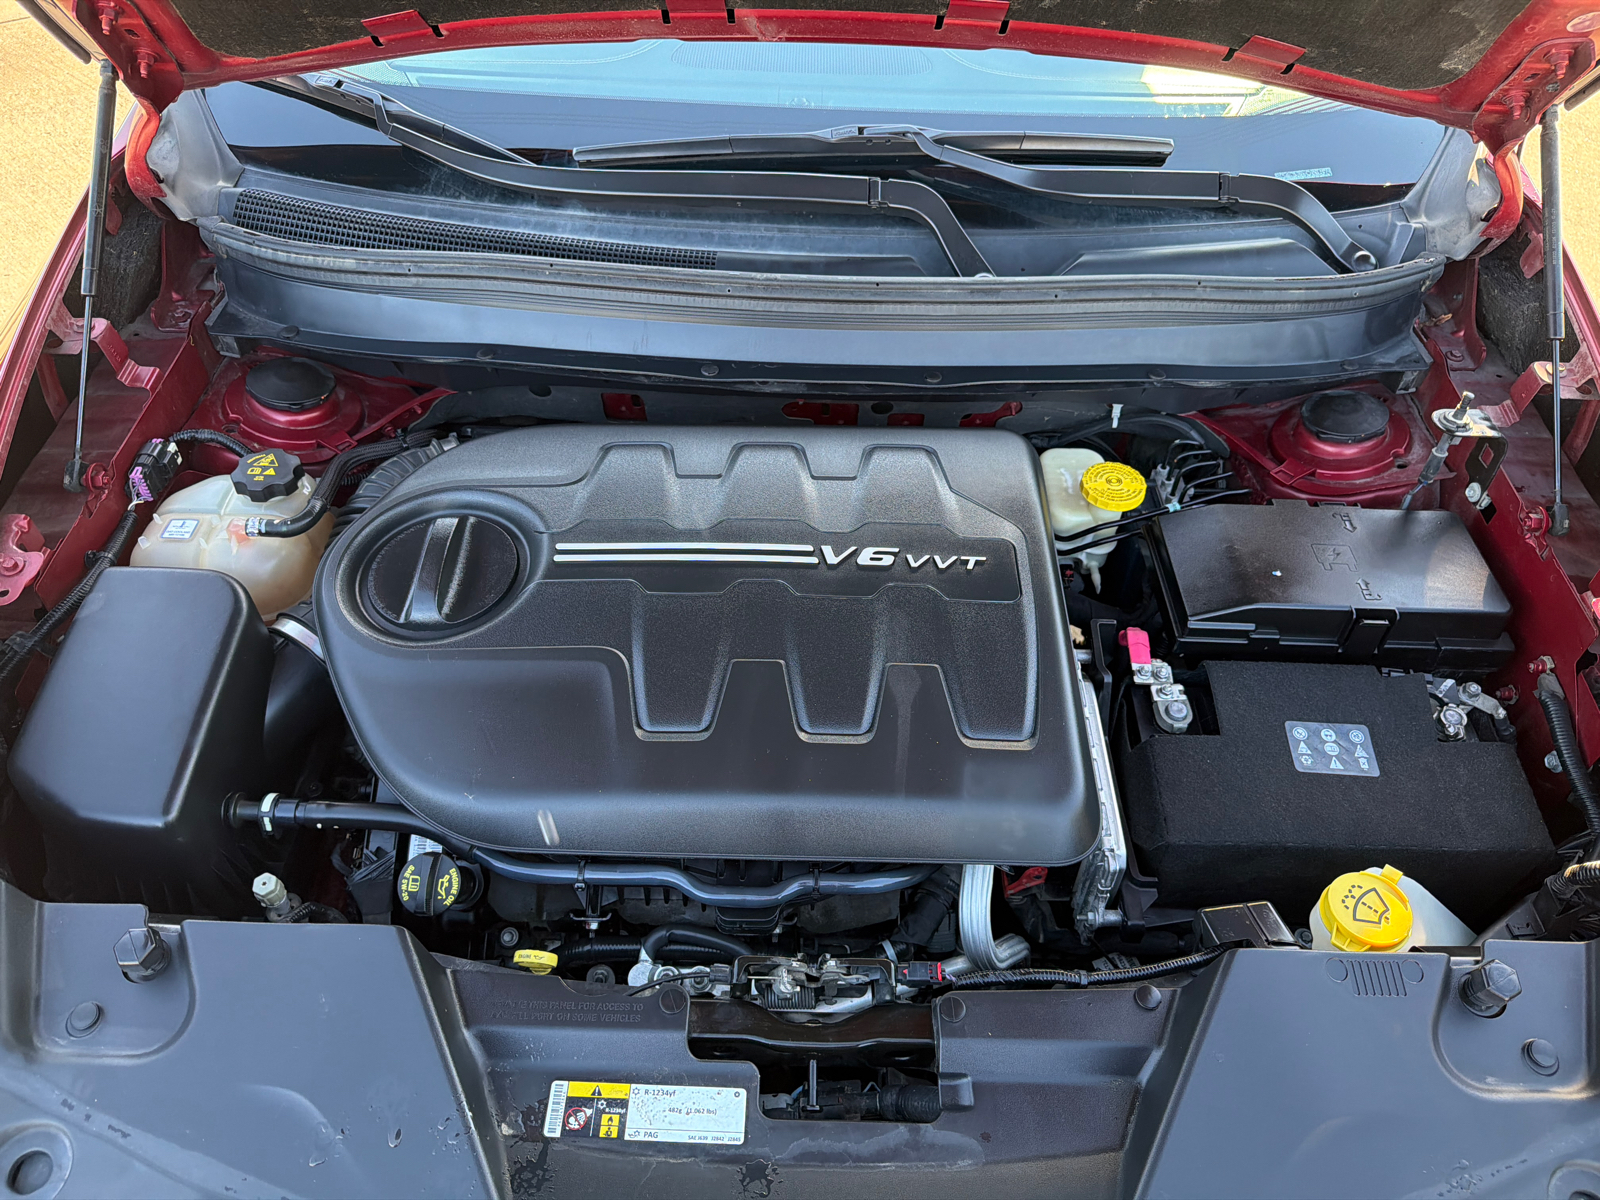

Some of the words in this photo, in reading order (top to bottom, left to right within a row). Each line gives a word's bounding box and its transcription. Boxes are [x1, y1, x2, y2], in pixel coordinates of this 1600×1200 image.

[820, 544, 900, 566] V6
[905, 554, 987, 570] VVT
[404, 864, 415, 878] SAE
[449, 867, 459, 895] ENGINE
[401, 879, 410, 901] 5W-20
[443, 895, 455, 906] OIL
[579, 1002, 595, 1010] FOR
[597, 1002, 630, 1011] ACCESS
[633, 1003, 644, 1011] TO
[557, 1012, 570, 1020] ON
[599, 1013, 641, 1022] VEHICLES
[644, 1088, 676, 1098] R-1234yf
[706, 1107, 717, 1116] lbs)
[643, 1131, 659, 1139] PAG
